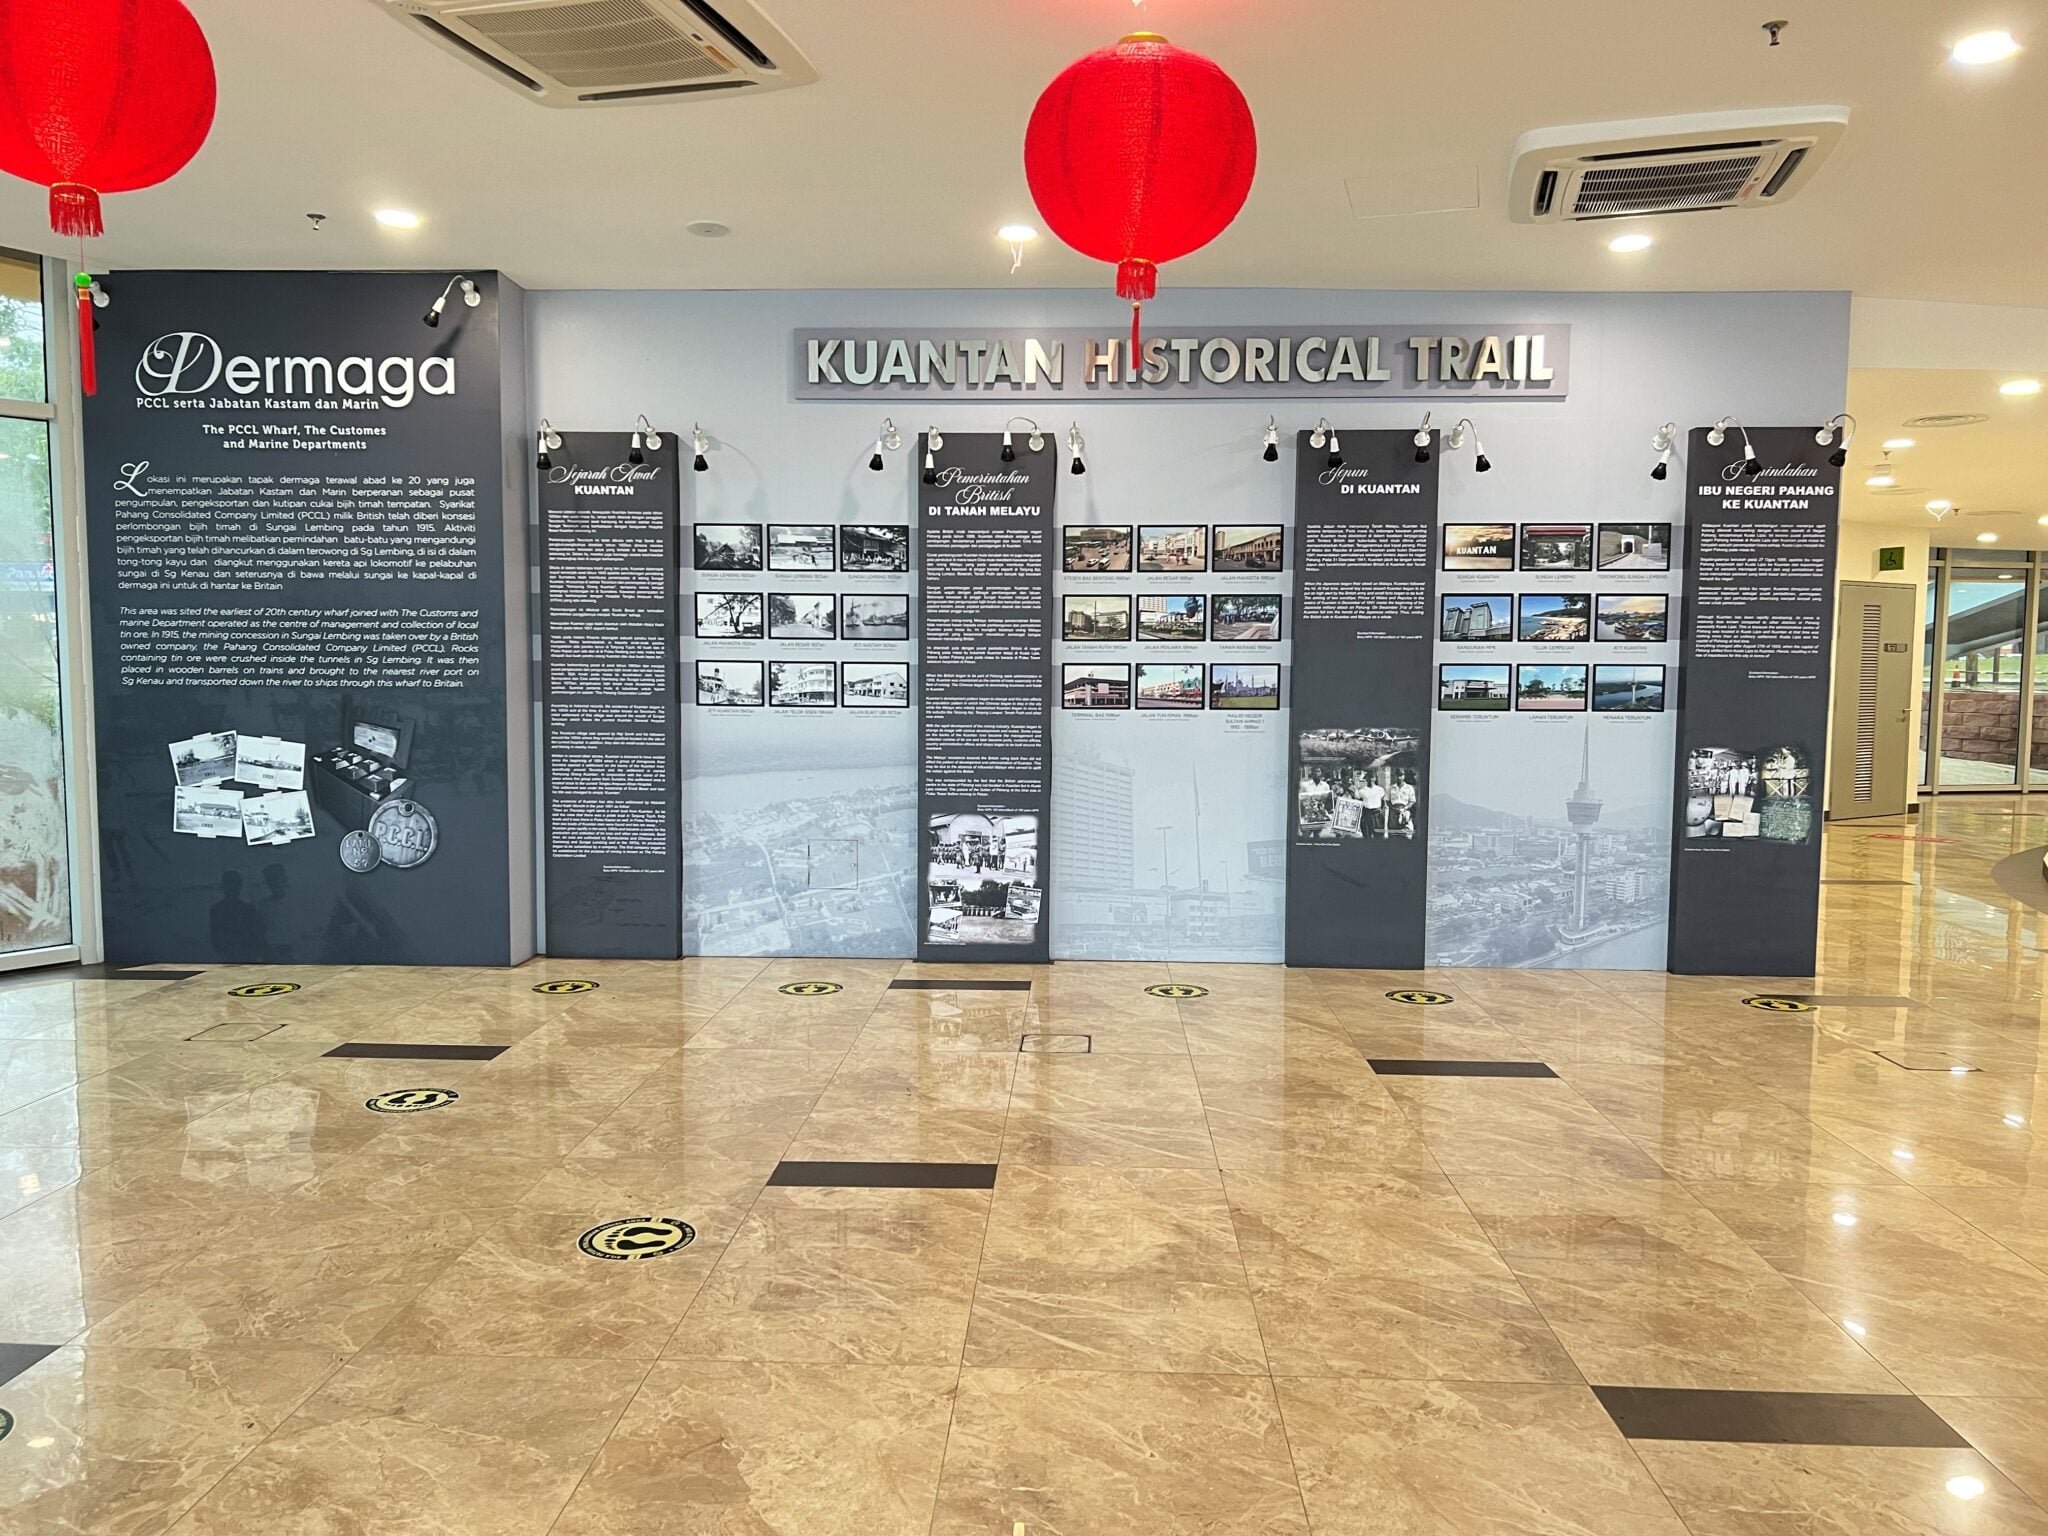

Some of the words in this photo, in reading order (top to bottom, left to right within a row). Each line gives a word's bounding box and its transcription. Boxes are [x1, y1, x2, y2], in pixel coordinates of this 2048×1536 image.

[808, 339, 1062, 384] KUANTAN
[1084, 337, 1390, 382] HISTORICAL
[1409, 335, 1555, 381] TRAIL
[135, 331, 456, 408] Dermaga
[136, 398, 169, 409] PCCL
[173, 398, 205, 409] serta
[208, 398, 260, 409] Jabatan
[264, 398, 310, 409] Kastam
[314, 399, 338, 409] dan
[342, 399, 379, 409] Marin
[202, 424, 224, 434] The
[228, 425, 259, 434] PCCL
[261, 425, 300, 436] Wharf,
[303, 425, 326, 435] The
[329, 425, 386, 435] Customes
[222, 439, 245, 448] and
[248, 439, 288, 449] Marine
[292, 439, 366, 452] Departments
[548, 464, 608, 485] Sejarah
[610, 463, 661, 483] Awal
[1318, 462, 1368, 485] Jepun
[1721, 459, 1818, 482] Ppindahan
[175, 474, 186, 482] ini
[191, 474, 242, 485] merupakan
[248, 475, 274, 485] tapak
[279, 475, 320, 485] dermaga
[325, 475, 357, 483] terawal
[362, 475, 386, 484] abad
[391, 476, 403, 484] ke
[407, 476, 421, 484] 20
[426, 478, 449, 486] yang
[454, 476, 475, 486] juga
[935, 467, 1029, 488] Pemerintahan
[147, 487, 212, 497] menempatkan
[217, 487, 254, 495] Jabatan
[259, 487, 293, 495] Kastam
[298, 487, 316, 496] dan
[322, 488, 346, 496] Marin
[351, 488, 403, 498] berperanan
[408, 488, 443, 498] sebagai
[449, 488, 475, 498] pusat
[574, 485, 634, 495] KUANTAN
[955, 485, 1015, 505] British
[1341, 484, 1353, 494] DI
[1358, 484, 1420, 494] KUANTAN
[1699, 486, 1721, 496] IBU
[1725, 486, 1775, 496] NEGERI
[1779, 486, 1834, 496] PAHANG
[181, 498, 249, 509] pengeksportan
[252, 499, 270, 507] dan
[272, 499, 307, 509] kutipan
[309, 499, 334, 507] cukai
[336, 499, 355, 509] bijih
[358, 499, 384, 507] timah
[438, 500, 475, 510] Syarikat
[1722, 499, 1741, 509] KE
[1744, 499, 1809, 510] KUANTAN
[115, 510, 149, 520] Pahang
[152, 510, 211, 518] Consolidated
[213, 510, 257, 521] Company
[260, 511, 294, 519] Limited
[297, 511, 330, 521] (PCCL)
[333, 511, 354, 519] milik
[356, 511, 385, 519] British
[387, 511, 410, 519] telah
[412, 511, 438, 519] diberi
[441, 511, 475, 519] konsesi
[928, 506, 941, 516] DI
[944, 506, 987, 516] TANAH
[989, 506, 1041, 516] MELAYU
[1456, 546, 1497, 555] KUANTAN
[120, 642, 151, 650] owned
[203, 642, 218, 650] the
[222, 642, 258, 652] Pahang
[262, 642, 321, 651] Consolidated
[325, 643, 368, 653] Company
[372, 643, 407, 651] Limited
[450, 644, 479, 652] Rocks
[120, 653, 167, 663] containing
[171, 654, 182, 662] tin
[230, 654, 267, 662] crushed
[269, 654, 296, 662] inside
[299, 654, 315, 662] the
[318, 654, 350, 663] tunnels
[353, 655, 362, 663] in
[365, 655, 379, 665] Sg
[426, 655, 434, 663] It
[458, 655, 479, 663] then
